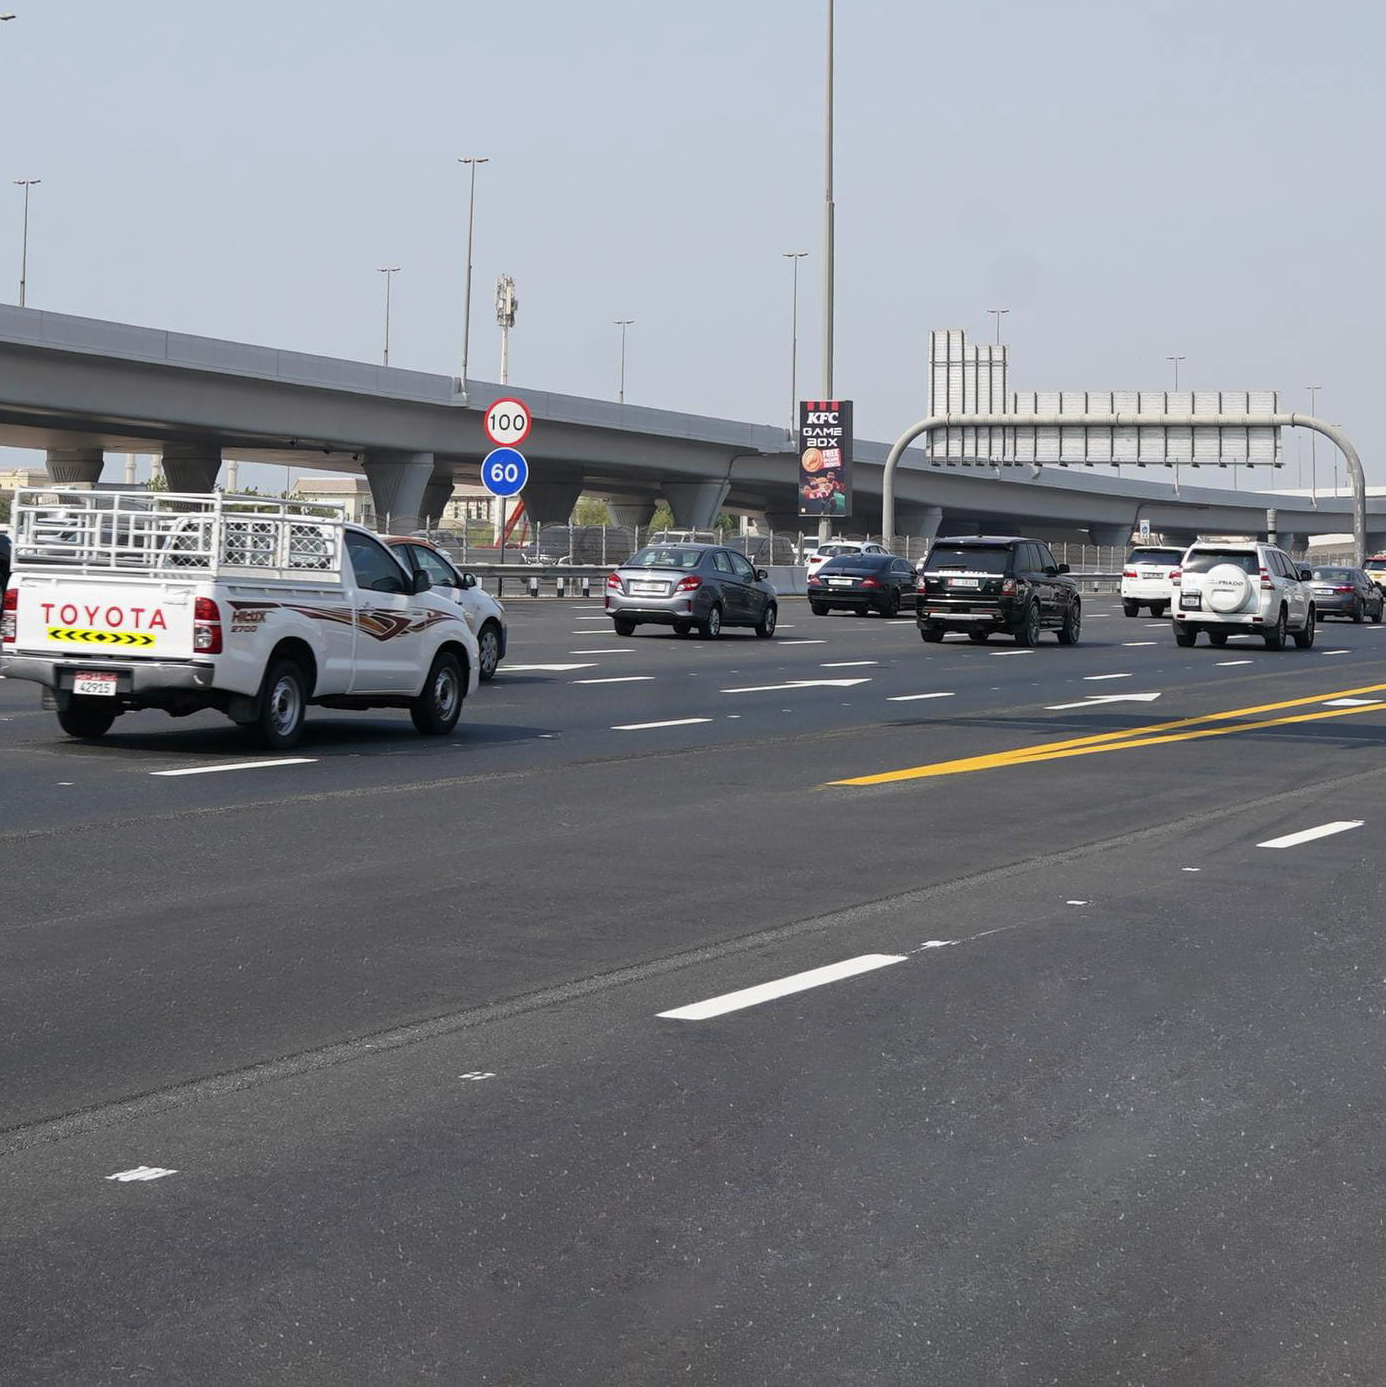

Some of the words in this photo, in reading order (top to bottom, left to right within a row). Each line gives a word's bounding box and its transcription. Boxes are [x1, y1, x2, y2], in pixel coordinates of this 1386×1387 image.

[490, 414, 525, 431] 100
[806, 412, 839, 425] KFC
[803, 427, 843, 436] GAME
[806, 437, 838, 447] BOX
[491, 463, 518, 483] 60
[41, 603, 168, 630] TOYOTA
[80, 682, 111, 694] 42915
